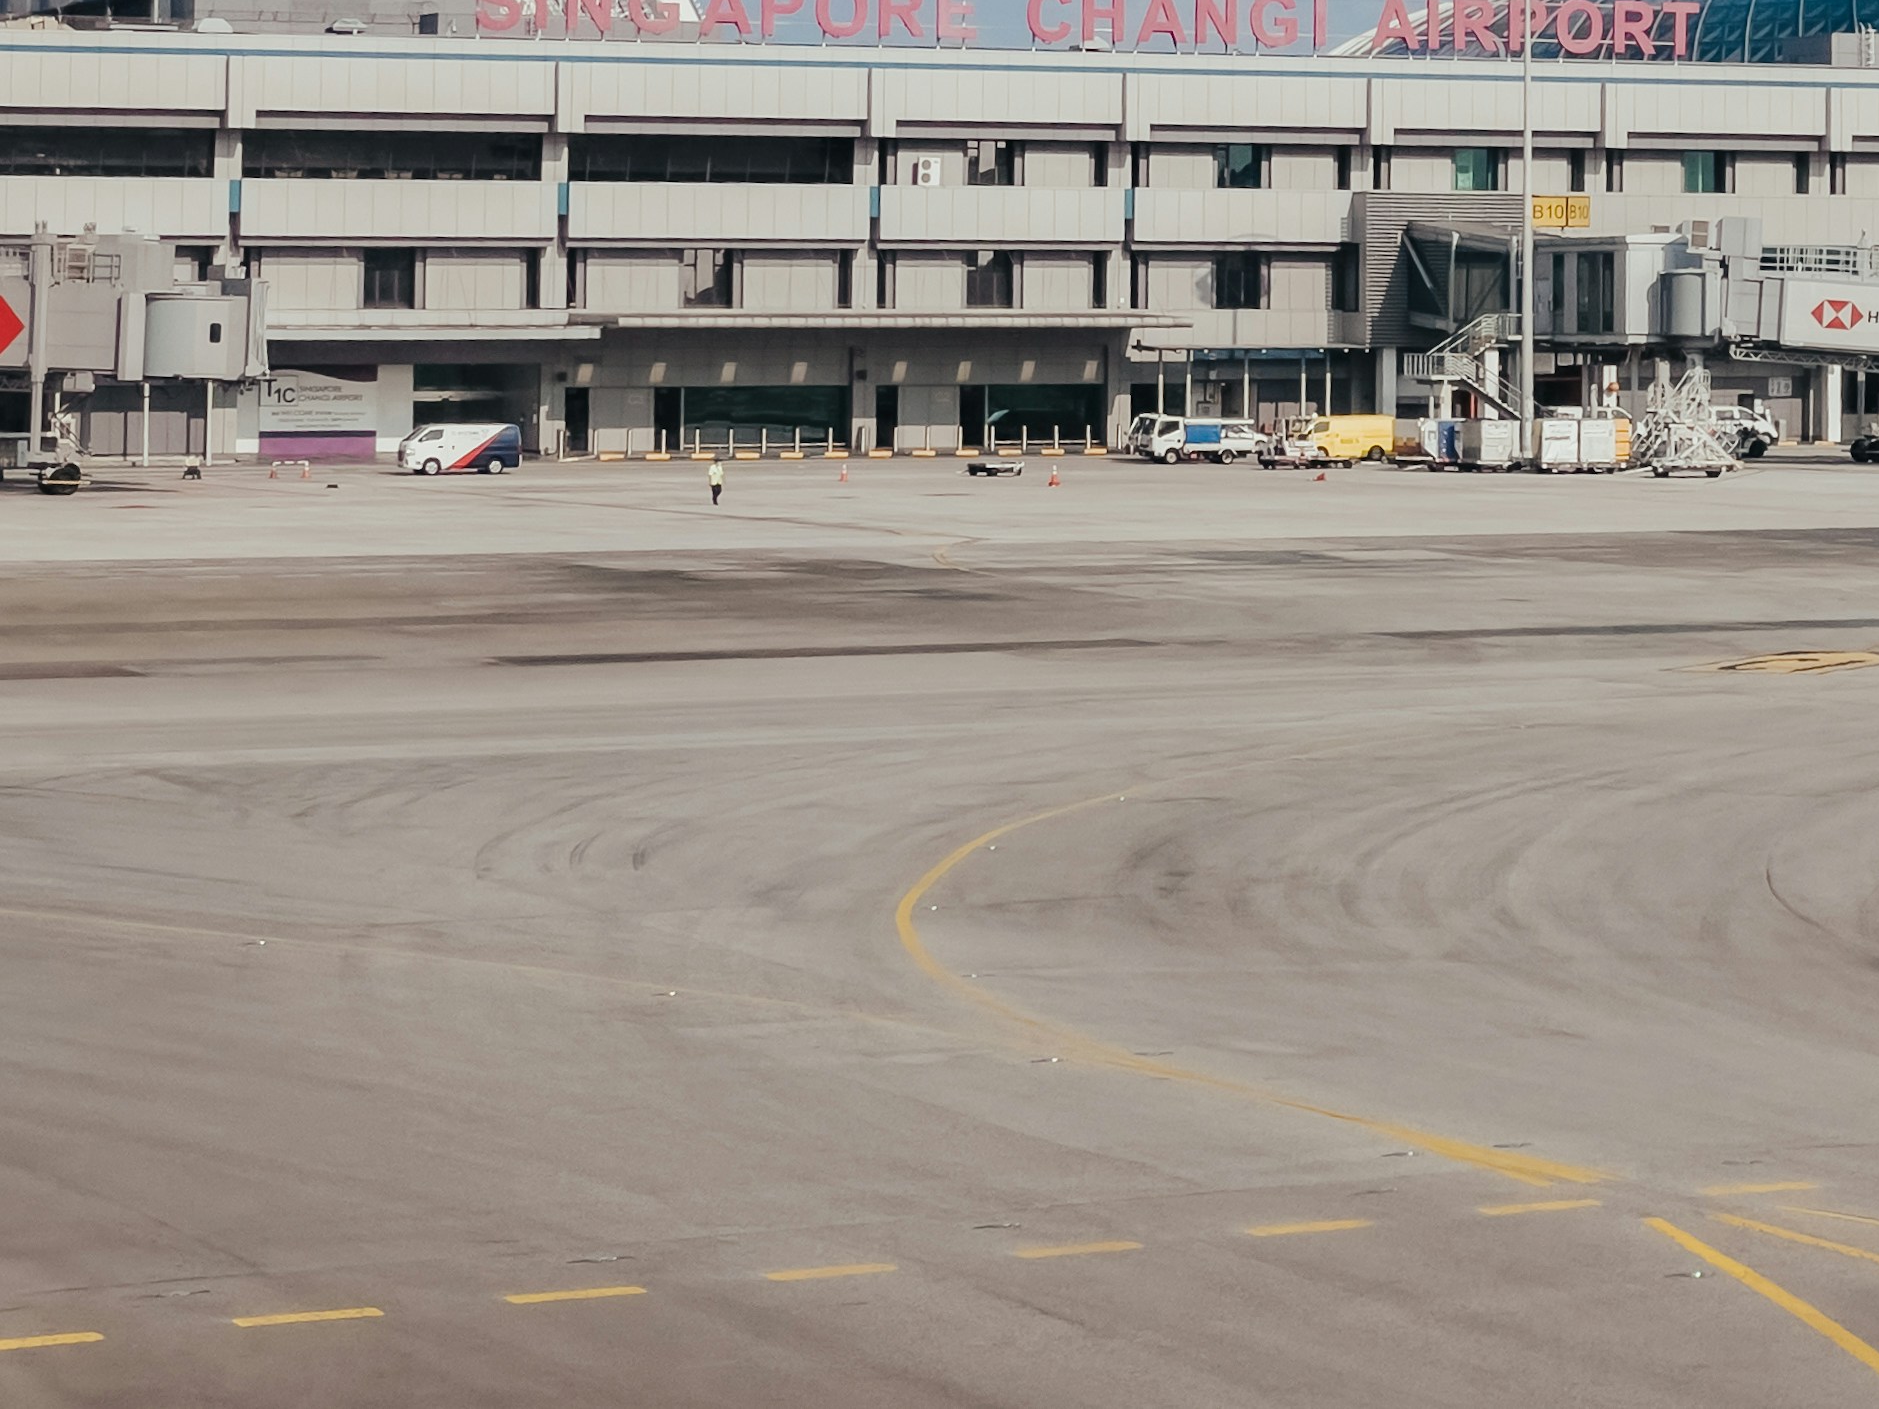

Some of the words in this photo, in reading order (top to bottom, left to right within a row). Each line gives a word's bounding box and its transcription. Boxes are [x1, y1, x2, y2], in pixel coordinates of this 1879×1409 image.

[1533, 204, 1564, 219] B10
[1569, 204, 1589, 219] B10
[263, 378, 296, 403] T1C
